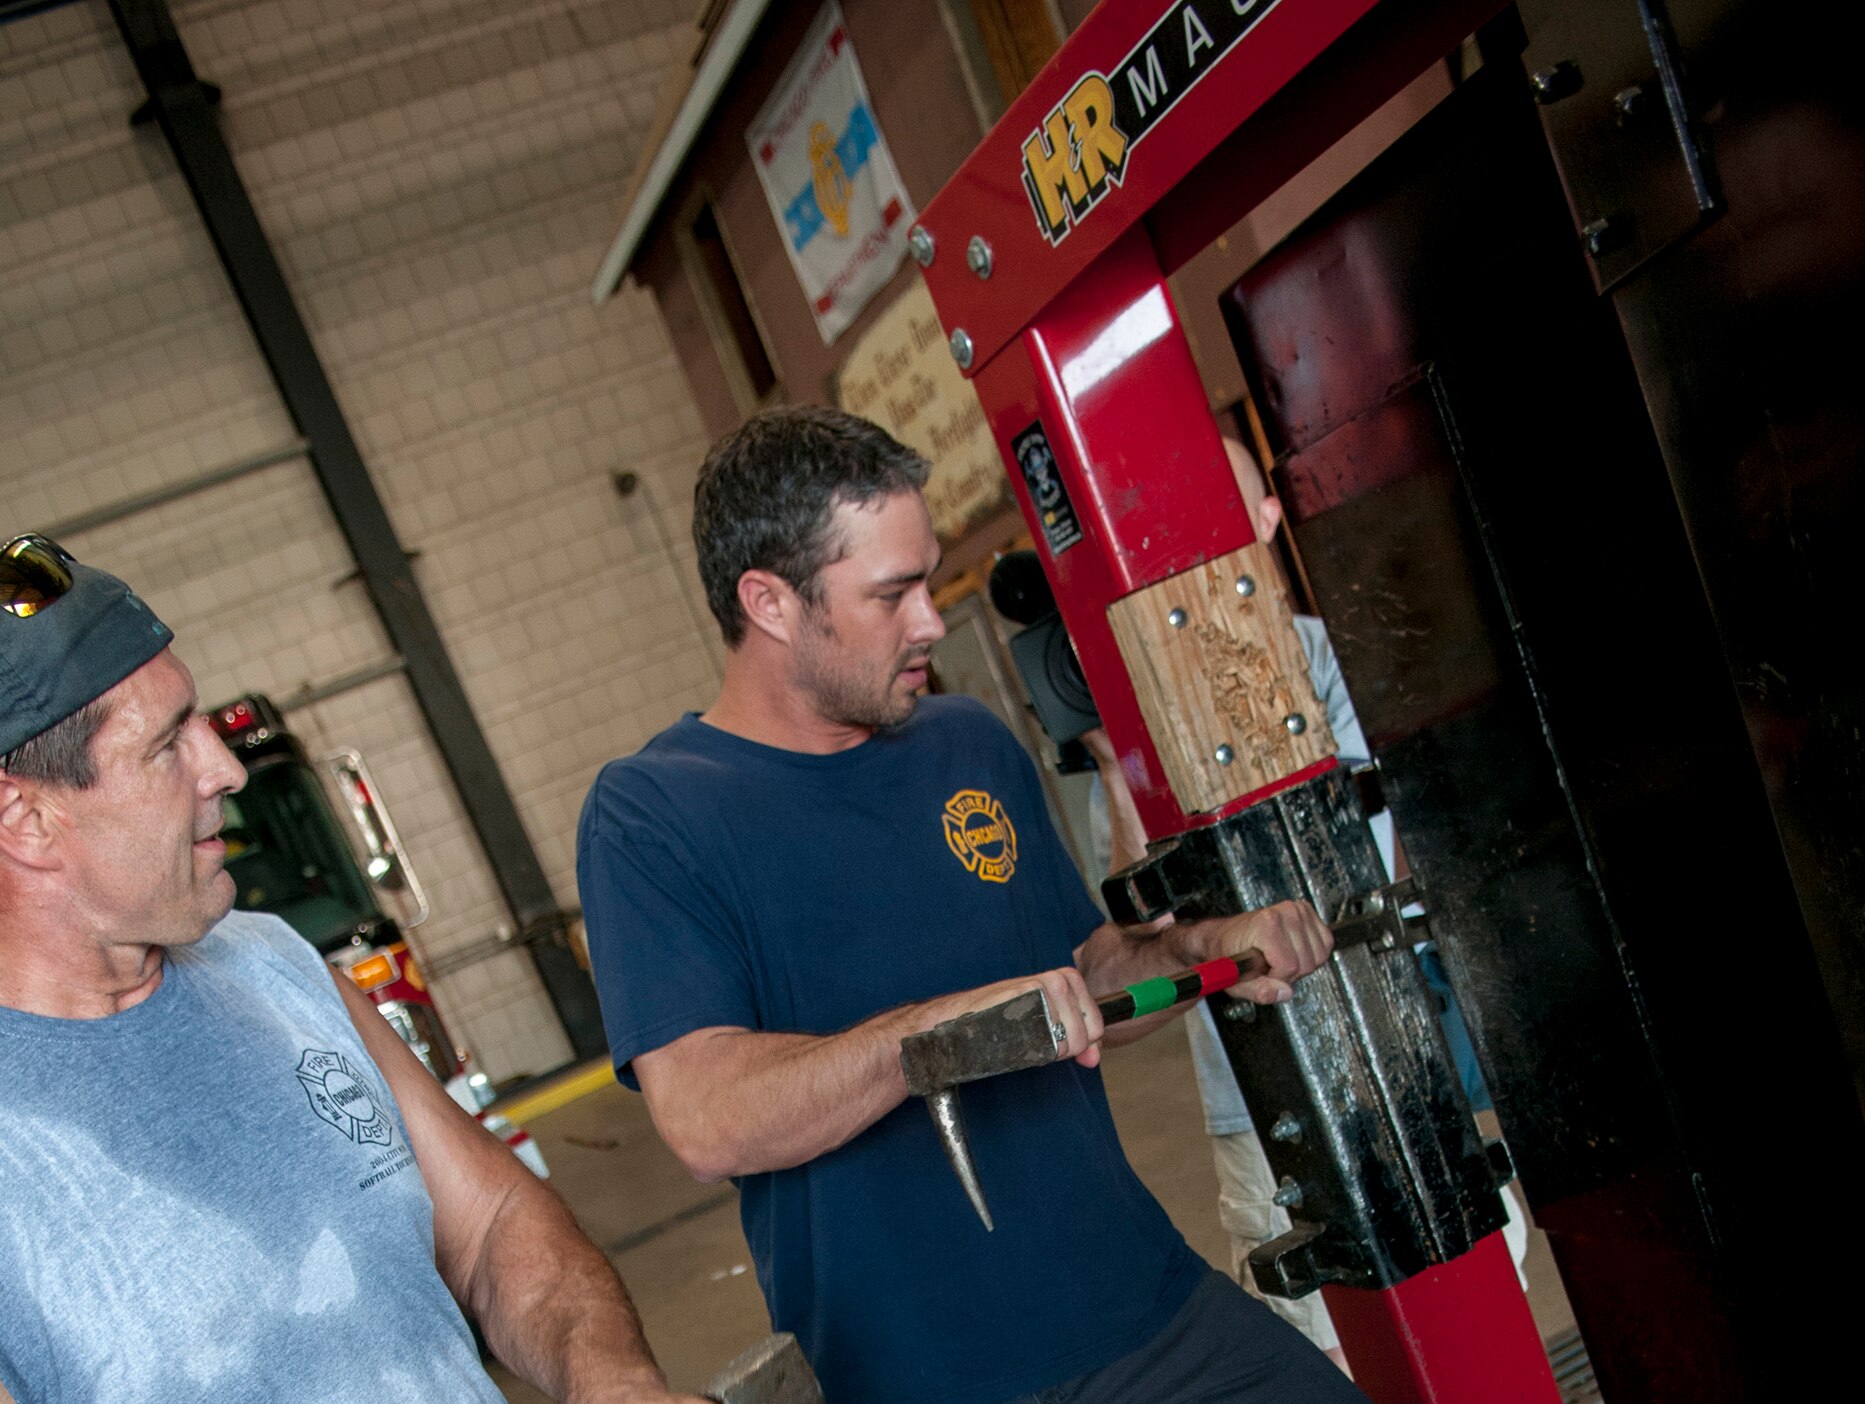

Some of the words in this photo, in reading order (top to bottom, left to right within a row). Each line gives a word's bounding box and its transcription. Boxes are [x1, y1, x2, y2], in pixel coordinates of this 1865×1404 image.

[1021, 72, 1129, 242] H&R
[1127, 0, 1264, 118] MA
[956, 797, 984, 813] FIRE
[307, 1055, 335, 1073] FIRE
[332, 1083, 366, 1107] CHICAGO
[359, 1163, 396, 1191] SOFTBALL
